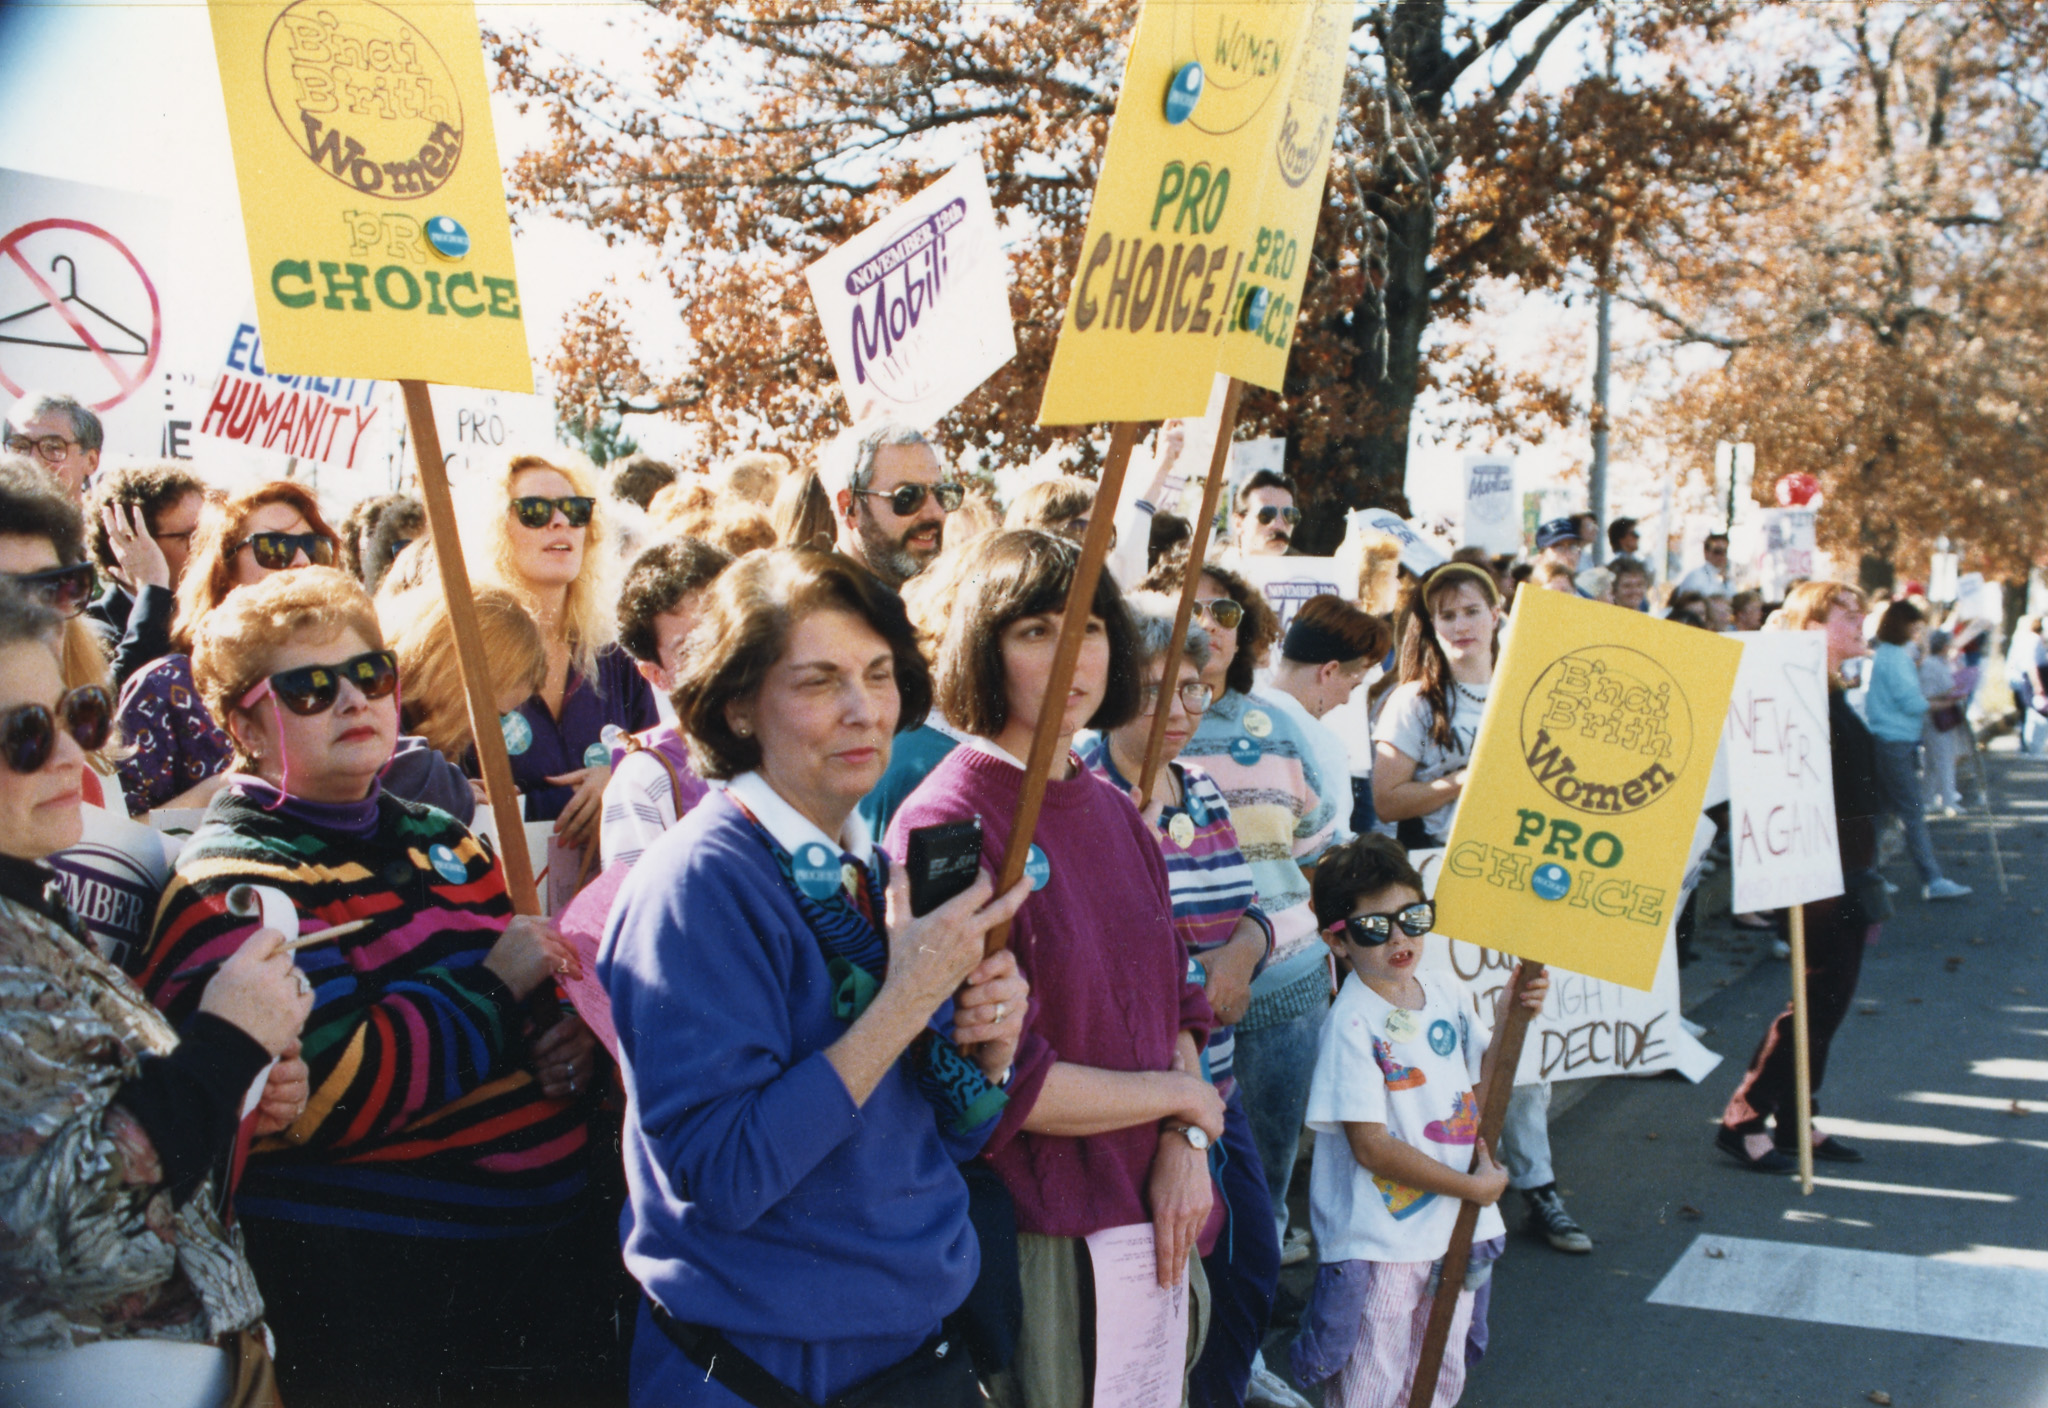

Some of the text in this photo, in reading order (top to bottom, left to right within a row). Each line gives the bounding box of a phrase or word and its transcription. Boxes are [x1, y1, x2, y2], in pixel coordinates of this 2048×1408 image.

[300, 109, 462, 193] Women
[1150, 160, 1231, 235] PRO
[343, 209, 428, 265] PR
[850, 222, 934, 294] NOVEMBER
[1248, 225, 1298, 280] PRO
[270, 258, 522, 320] CHOICE
[1074, 231, 1245, 338] CHOICE!
[200, 374, 378, 469] HUMANITY
[1542, 691, 1673, 759] B'rith
[1729, 689, 1821, 788] NEVER
[1527, 729, 1675, 812] Women
[1513, 808, 1624, 869] PRO
[1738, 802, 1833, 868] AGAIN
[1449, 840, 1667, 926] CHICE
[1540, 1010, 1671, 1079] DECIDE
